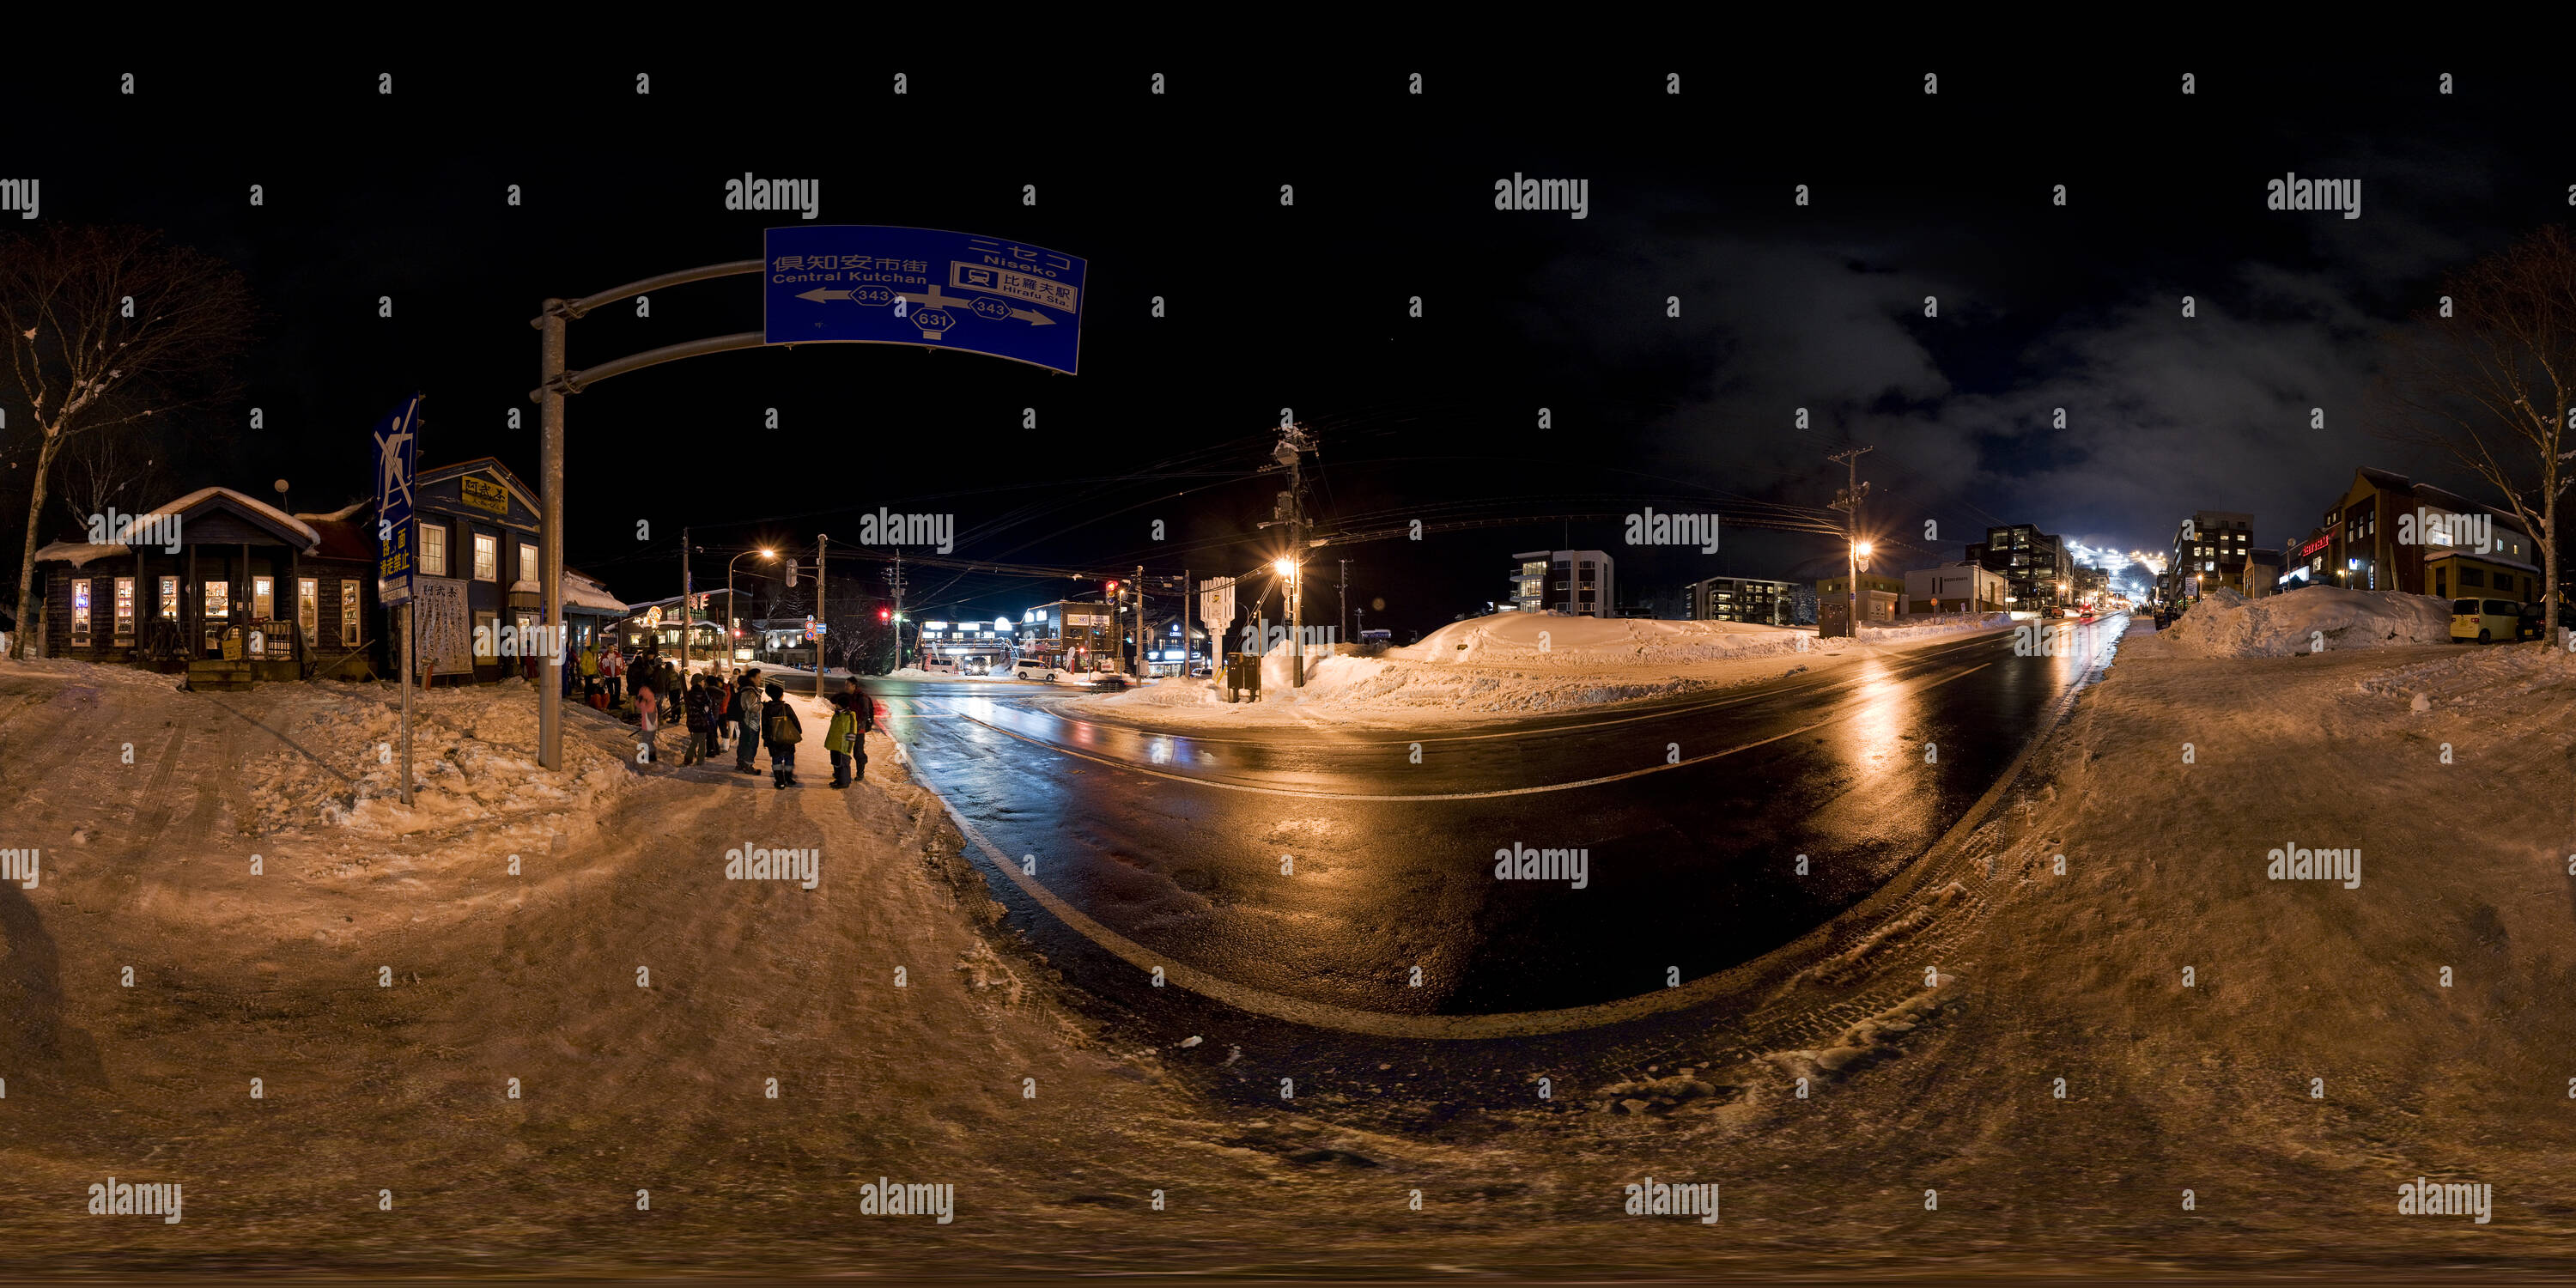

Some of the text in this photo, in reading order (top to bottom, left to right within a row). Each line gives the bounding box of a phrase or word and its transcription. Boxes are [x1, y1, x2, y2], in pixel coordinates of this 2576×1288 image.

[969, 239, 1071, 271] ニセコ
[983, 255, 1057, 278] Niseko
[772, 271, 927, 285] Central Kutchan
[1003, 274, 1071, 300] 比羅夫駅
[858, 290, 890, 301] 343
[1003, 285, 1070, 308] Hirafu Sta.
[976, 301, 1005, 315] 343
[919, 313, 947, 327] 631
[380, 549, 410, 578] 滑走禁止
